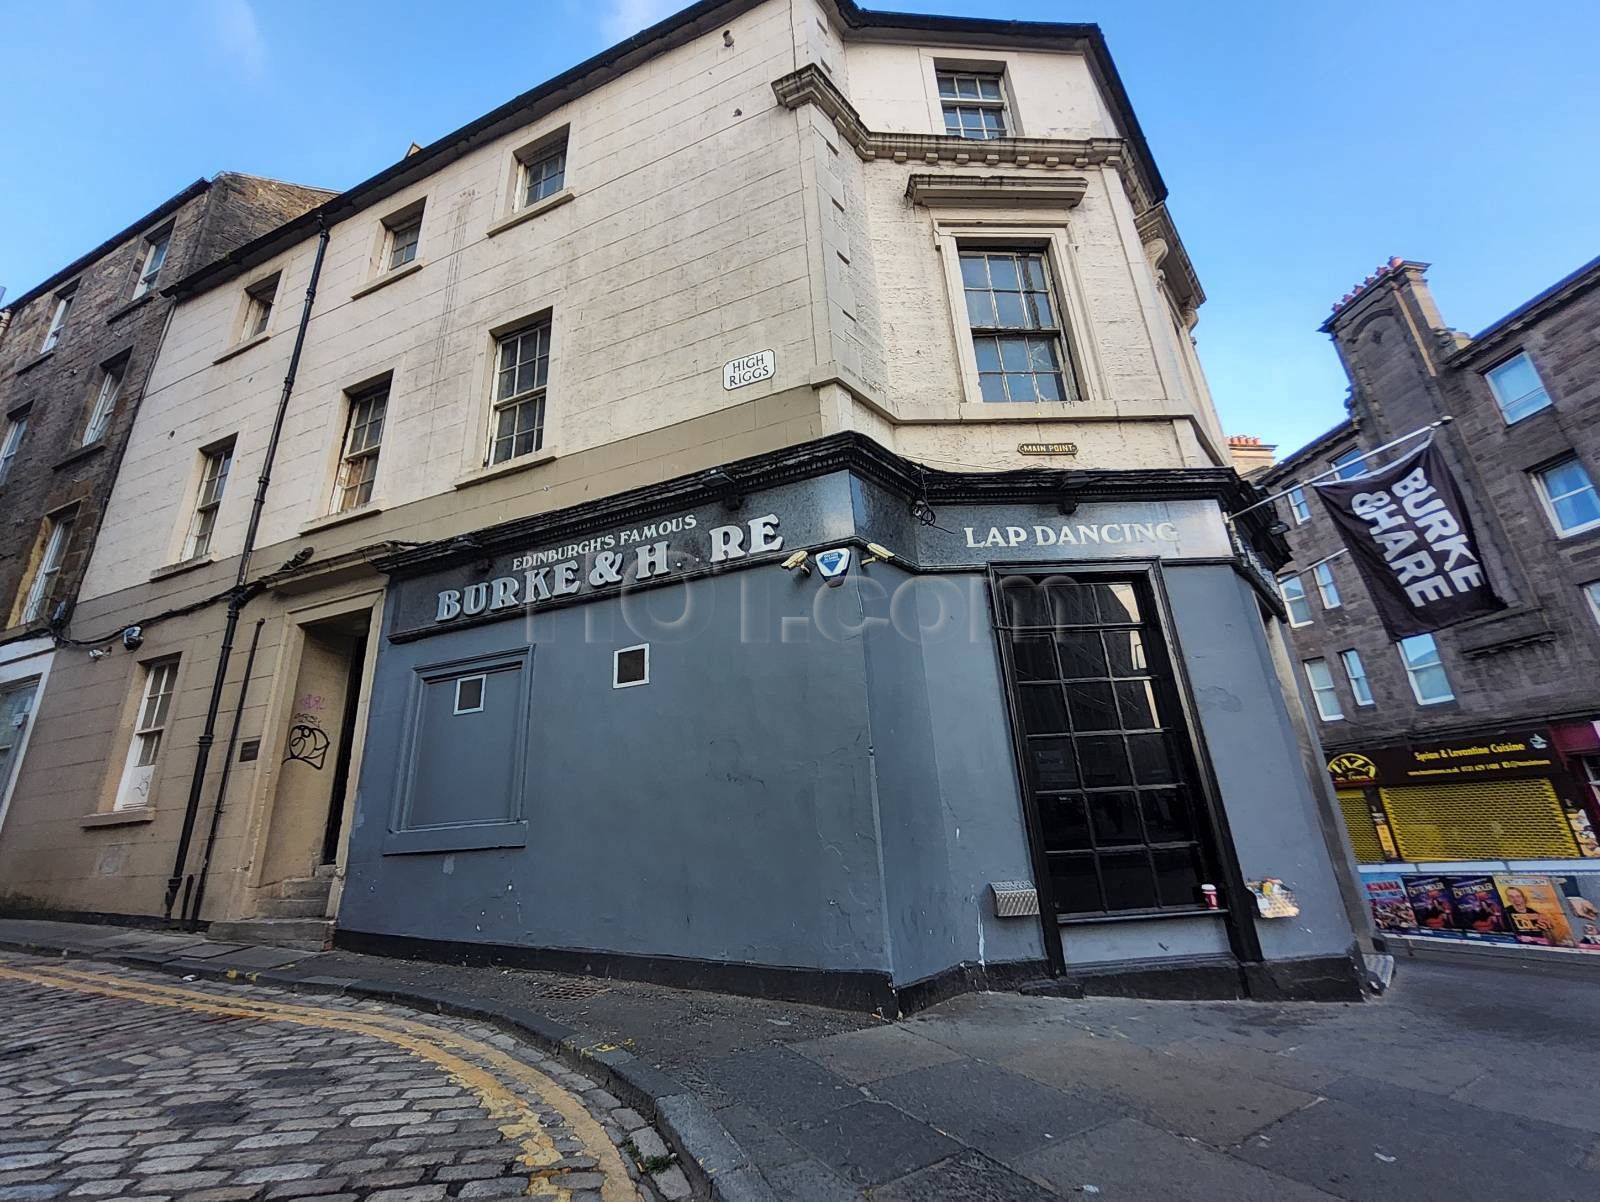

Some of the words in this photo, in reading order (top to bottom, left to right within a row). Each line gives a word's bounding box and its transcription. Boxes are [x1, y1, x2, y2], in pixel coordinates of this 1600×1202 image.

[732, 353, 764, 374] HIGH
[729, 365, 769, 387] RIGGS
[1023, 444, 1047, 453] MAIN
[1048, 444, 1074, 453] POINT
[963, 526, 1028, 548] LAP
[1034, 522, 1181, 547] DANCING
[1391, 467, 1485, 593] BURKE
[512, 534, 616, 571] EDINBURGH'S
[619, 514, 698, 546] FAMOUS
[435, 559, 582, 622] BURKE
[588, 550, 624, 587] &
[1490, 742, 1526, 753] Cuisine
